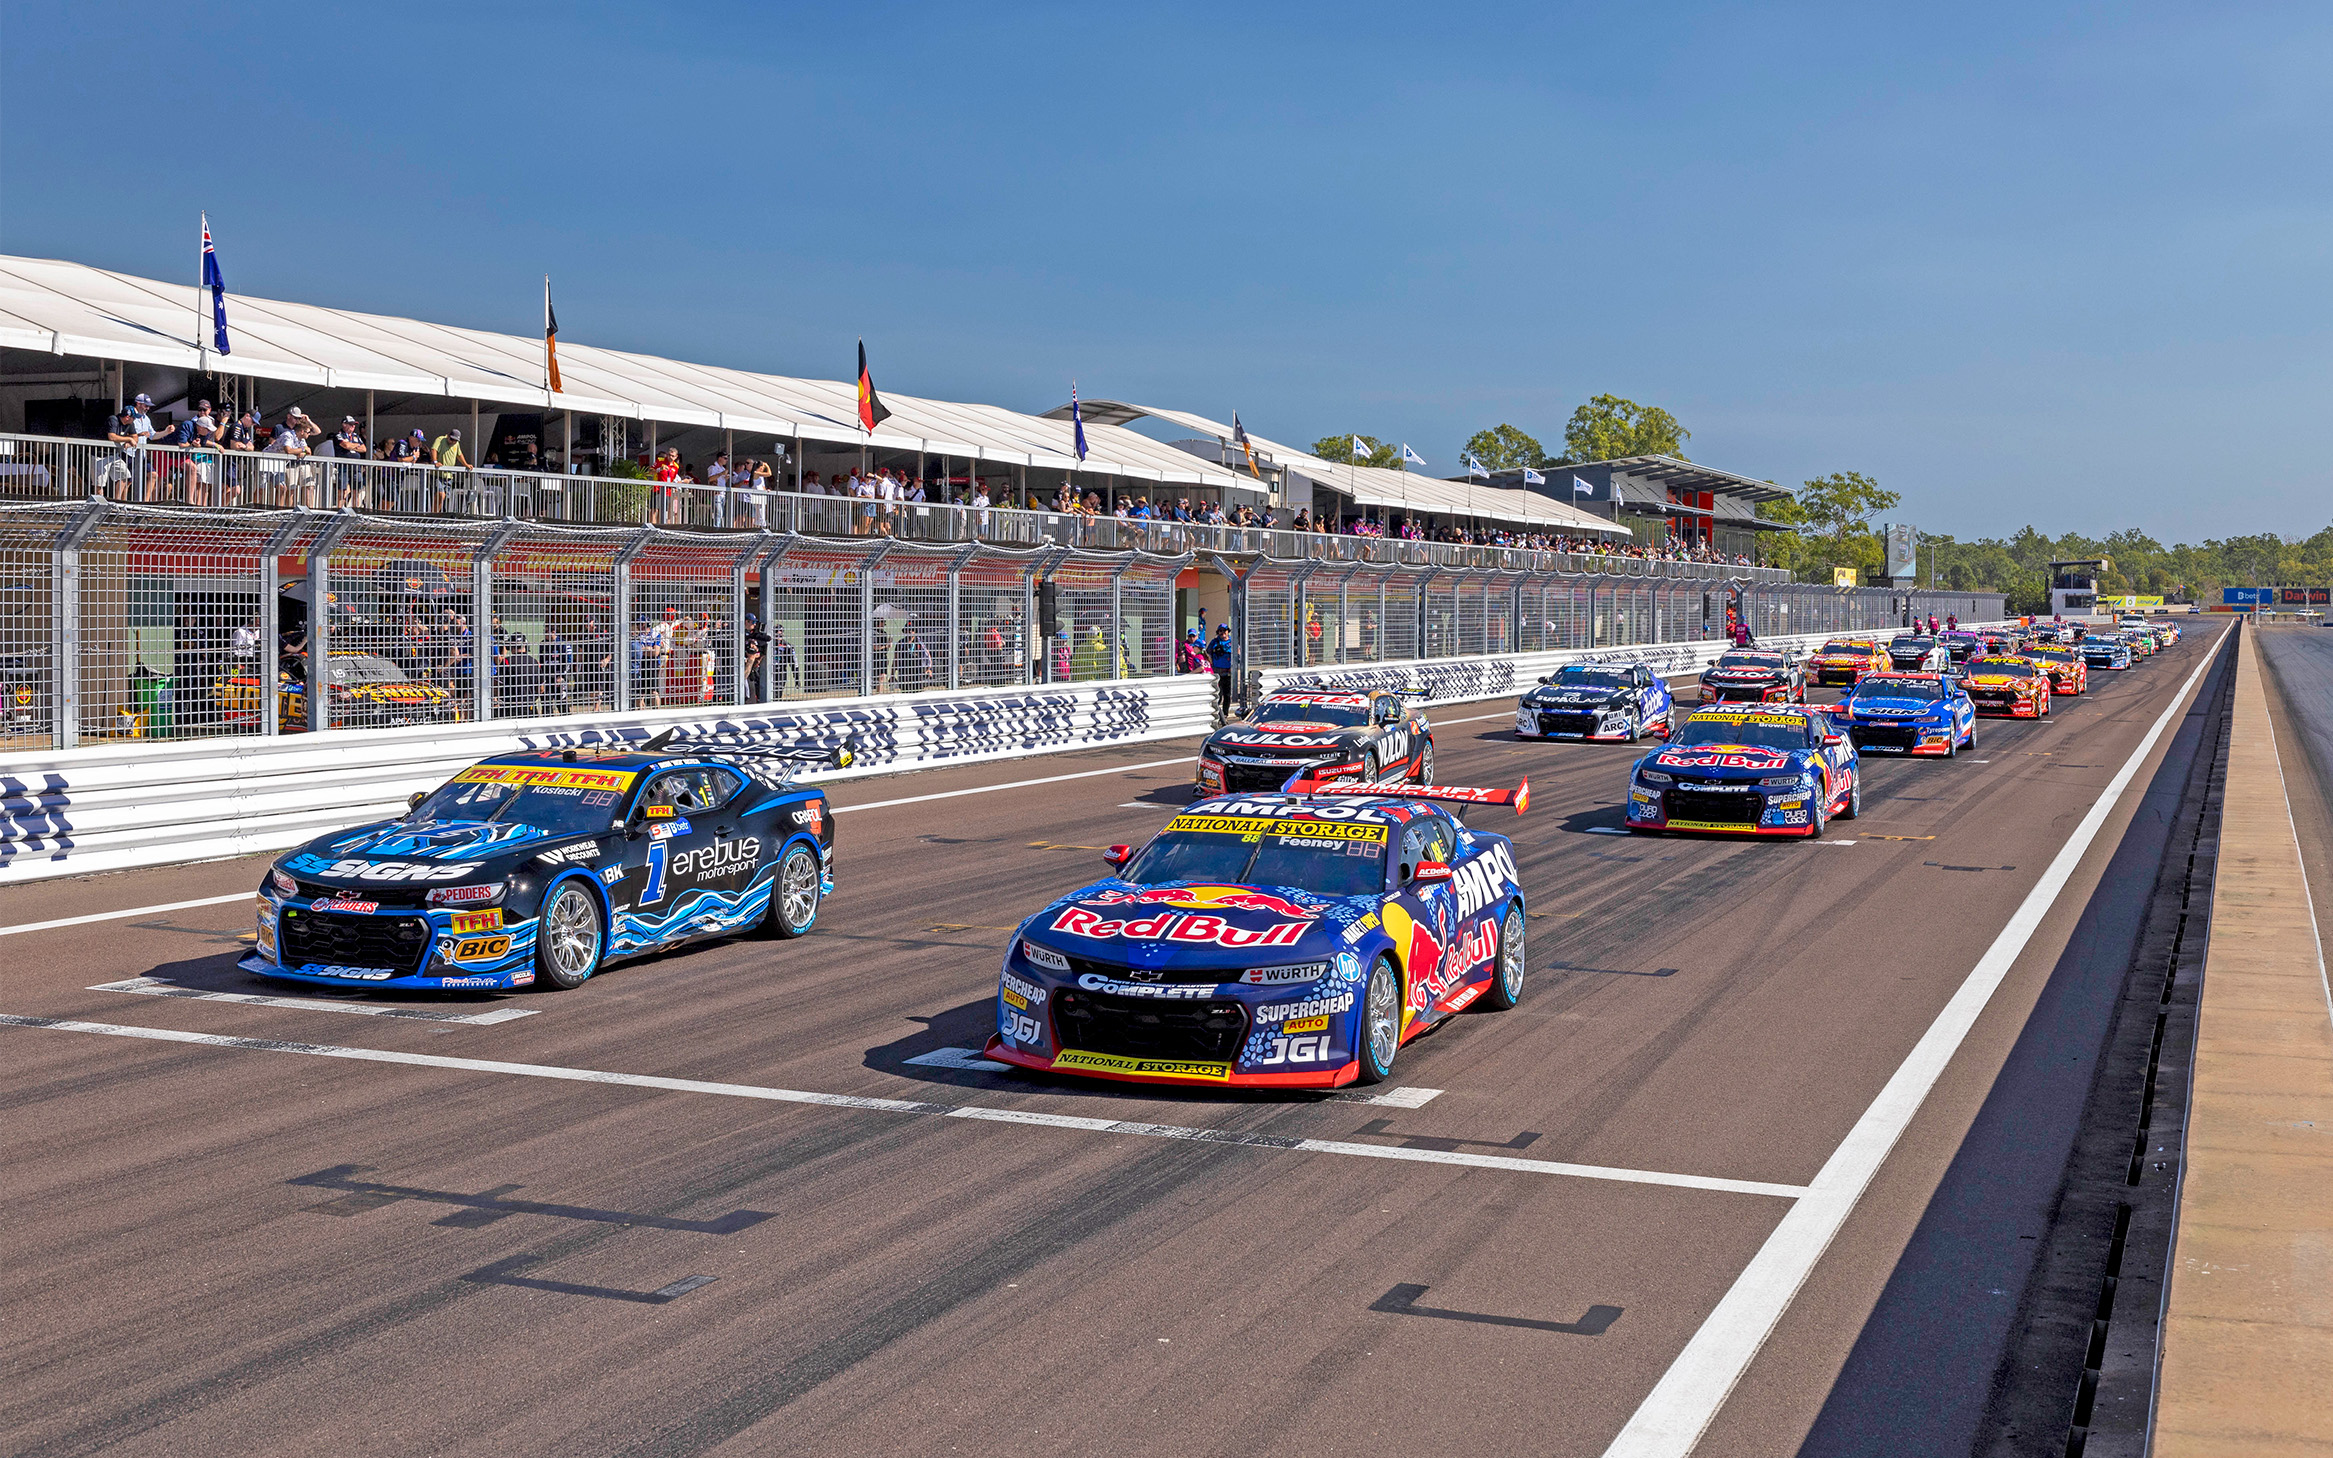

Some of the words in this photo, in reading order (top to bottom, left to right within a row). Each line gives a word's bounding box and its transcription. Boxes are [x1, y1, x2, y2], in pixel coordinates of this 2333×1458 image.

[1267, 694, 1365, 705] HIFLEX
[1321, 704, 1351, 712] Golding
[1697, 706, 1803, 716] AMPOL
[1690, 714, 1743, 722] NATIONAL
[1220, 732, 1344, 747] NULON
[1377, 730, 1409, 768] NULON
[1656, 753, 1719, 767] Red
[1720, 755, 1788, 770] Bull
[464, 769, 507, 780] TFH
[566, 773, 616, 787] TFH
[1318, 767, 1342, 775] ISUZU
[531, 786, 584, 797] Kostecki
[1347, 783, 1497, 797] AMPLIFY
[1767, 790, 1812, 805] SUPERCHEAP
[649, 807, 669, 815] TFH
[792, 809, 822, 825] ORAFOL
[1187, 801, 1387, 823] AMPOL
[1169, 818, 1266, 832] NATIONAL
[1275, 821, 1379, 840] STORAGE
[1241, 834, 1261, 843] 88
[1279, 836, 1346, 850] Feeney
[560, 840, 598, 855] WORKWEAR
[565, 848, 601, 861] DISCOUNTS
[672, 837, 760, 876] erebus
[638, 839, 669, 907] 1
[697, 858, 759, 882] motorsport
[1452, 841, 1521, 924] AMPOL
[446, 886, 492, 901] PEDDERS
[325, 898, 379, 914] PEDDERS
[455, 911, 497, 931] TFH
[1050, 907, 1174, 939] Red
[1168, 914, 1315, 948] Bull
[1444, 931, 1468, 986] Red
[1464, 917, 1498, 972] Bull
[1341, 959, 1358, 979] hp
[1002, 970, 1047, 1006] PERCHEAP
[1078, 973, 1216, 999] COMPLETE
[1005, 991, 1026, 1006] AUTO
[1256, 991, 1355, 1024] SUPERCHEAP
[1003, 1012, 1042, 1045] JGI
[1287, 1018, 1324, 1031] AUTO
[1262, 1035, 1331, 1065] JGI
[1058, 1053, 1134, 1070] NATIONAL
[1142, 1062, 1223, 1076] STORAGE
